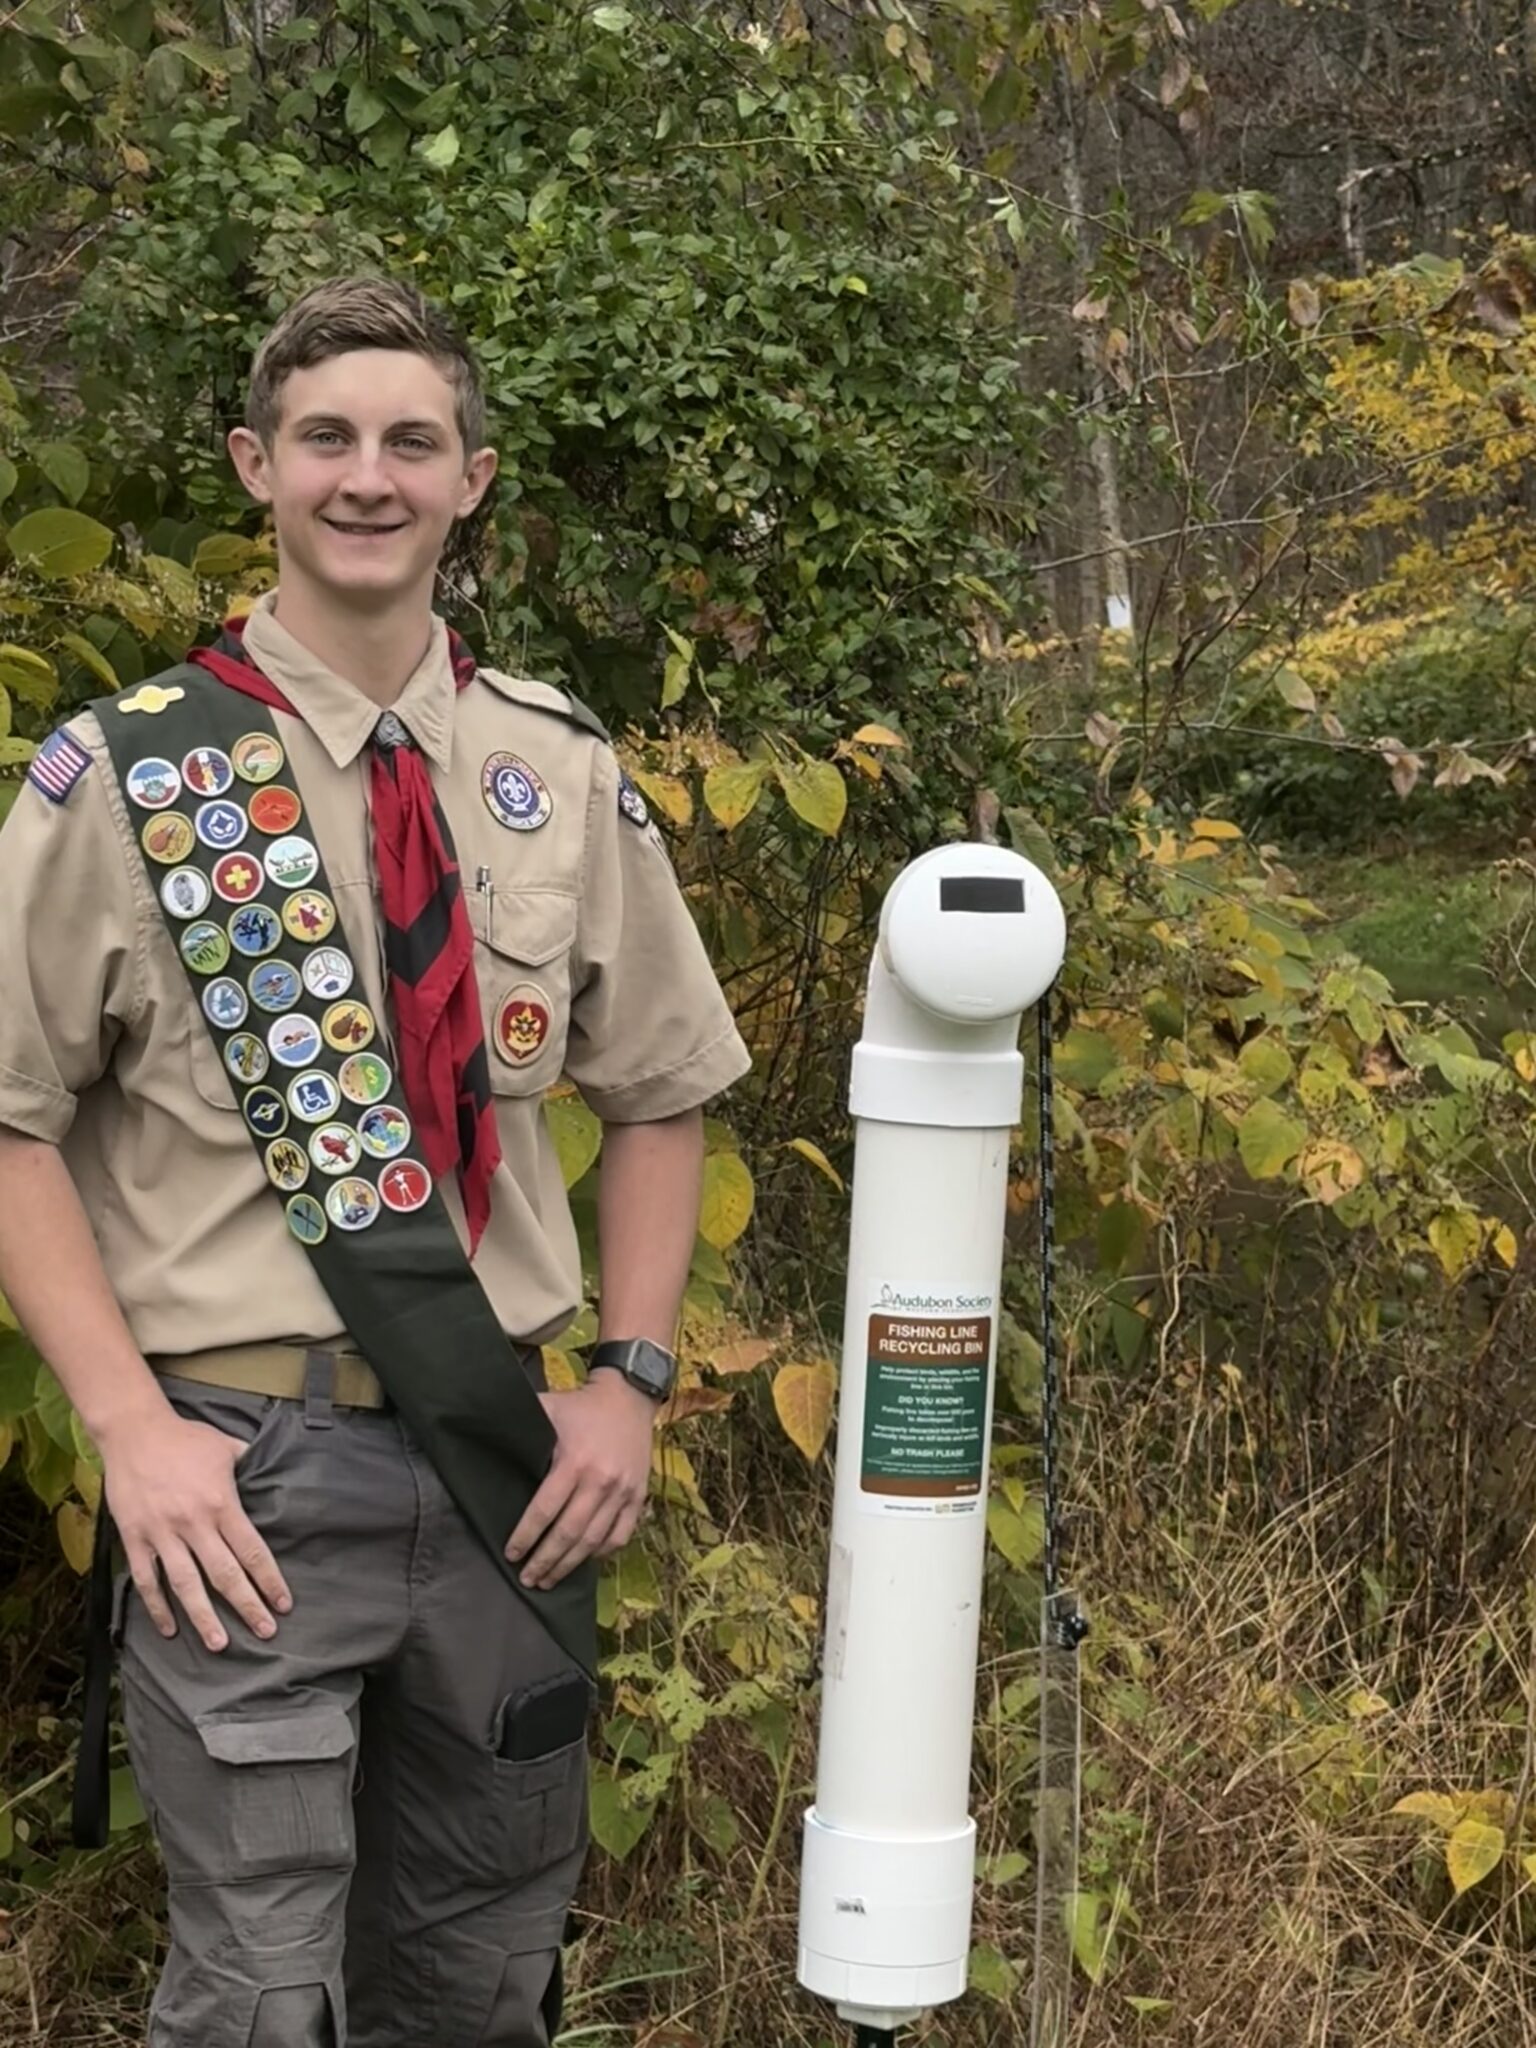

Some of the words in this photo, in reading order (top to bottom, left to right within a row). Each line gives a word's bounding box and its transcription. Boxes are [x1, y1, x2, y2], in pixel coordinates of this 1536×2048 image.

[893, 1294, 953, 1308] Audubon
[888, 1323, 947, 1339] FISHING
[949, 1325, 978, 1339] LINE
[879, 1338, 962, 1355] RECYCLING
[964, 1341, 983, 1354] BIN
[897, 1395, 914, 1404] DID
[915, 1396, 934, 1405] YOU
[890, 1446, 905, 1456] NO
[905, 1448, 935, 1457] TRASH
[935, 1448, 965, 1459] PLEASE
